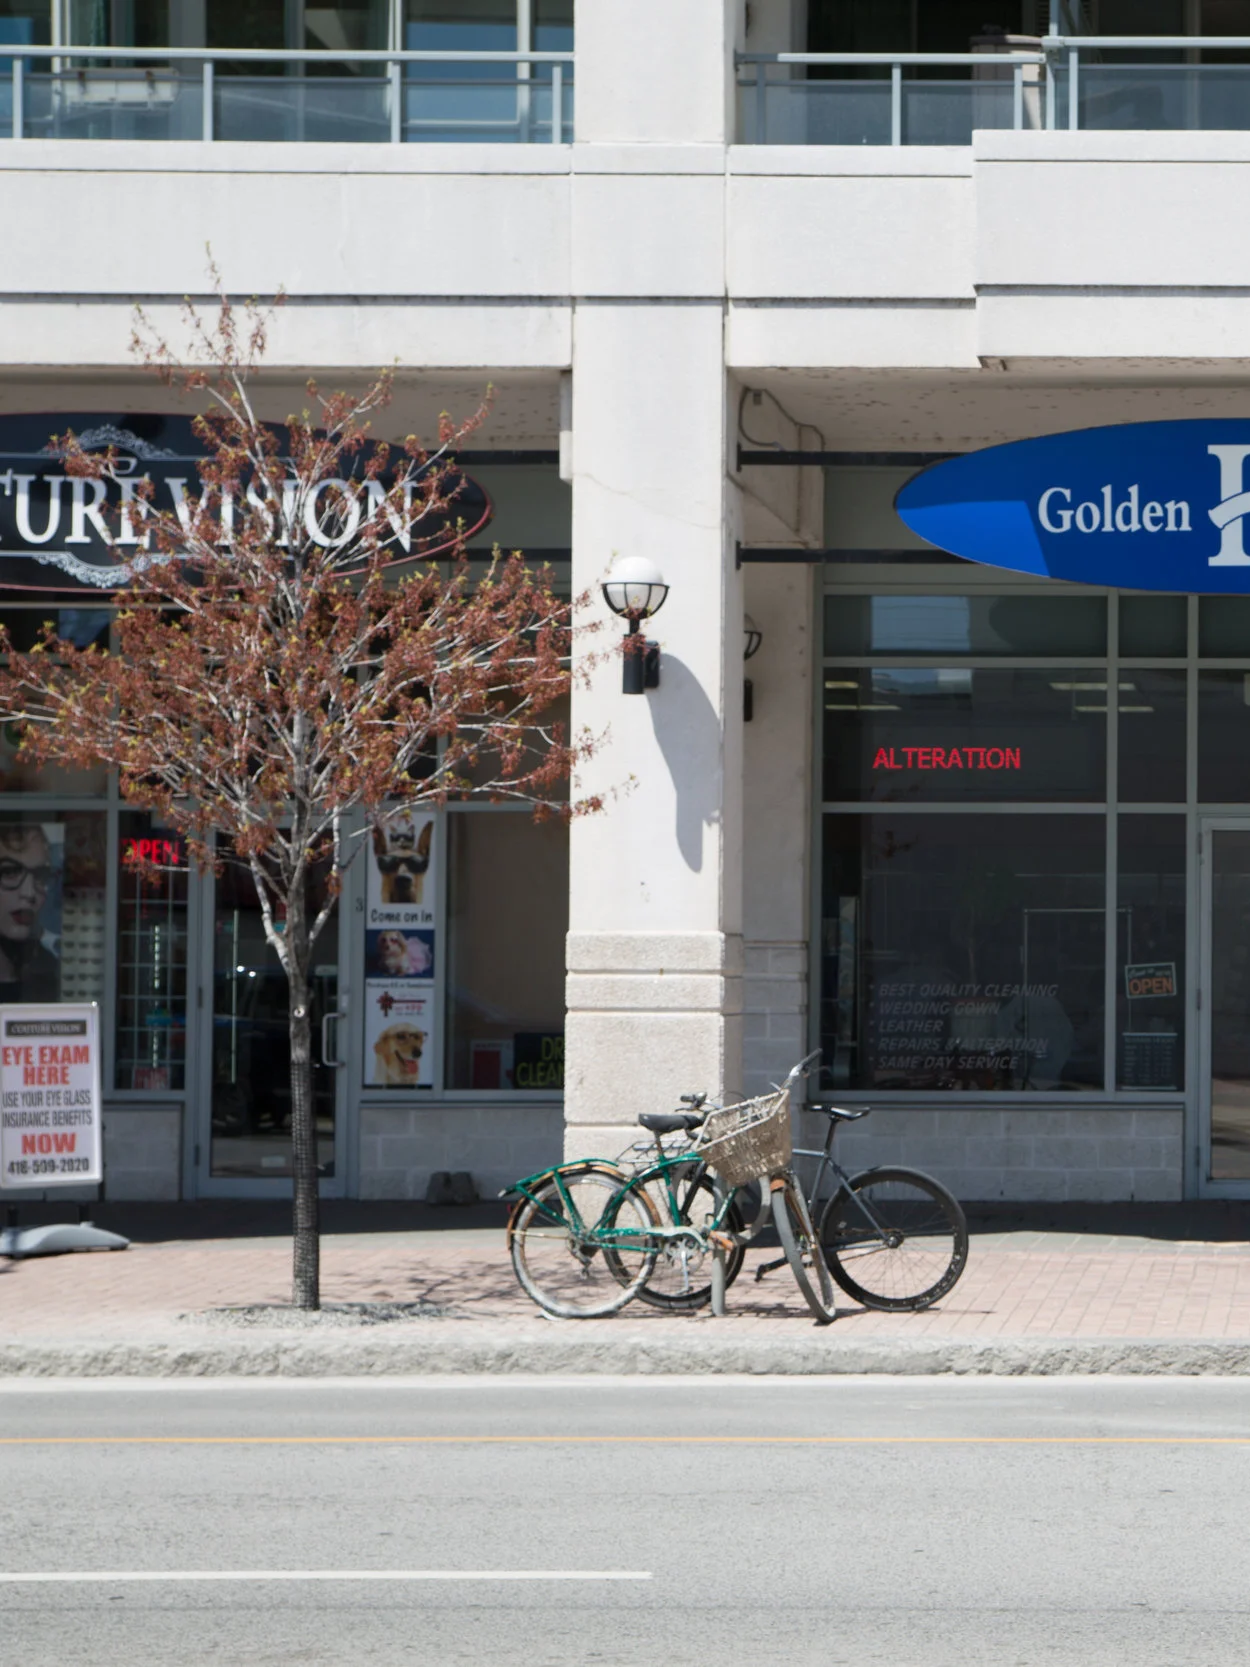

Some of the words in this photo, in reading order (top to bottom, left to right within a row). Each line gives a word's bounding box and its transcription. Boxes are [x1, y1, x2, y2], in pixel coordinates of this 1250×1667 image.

[0, 468, 151, 550] URE
[1038, 483, 1193, 533] Golden
[872, 747, 1021, 769] ALTERATION
[879, 983, 916, 997] BEST
[919, 983, 981, 997] QUALITY
[984, 983, 1059, 997] CLEANING
[1129, 977, 1173, 995] OPEN
[880, 1001, 951, 1015] WEDDING
[953, 1001, 1000, 1015] GOWN
[879, 1020, 944, 1033] LEATHER
[878, 1038, 941, 1051] REPAIRS
[2, 1046, 33, 1067] EYE
[38, 1044, 90, 1065] EXAM
[879, 1056, 922, 1069] SAME
[923, 1056, 955, 1069] DAY
[957, 1056, 1019, 1069] SERVICE
[23, 1066, 70, 1086] HERE
[2, 1092, 19, 1108] USE
[20, 1091, 44, 1107] YOUR
[46, 1091, 62, 1106] EYE
[63, 1089, 92, 1105] GLASS
[2, 1111, 50, 1128] INSURANCE
[52, 1109, 93, 1126] BENEFITS
[21, 1132, 77, 1155] NOW
